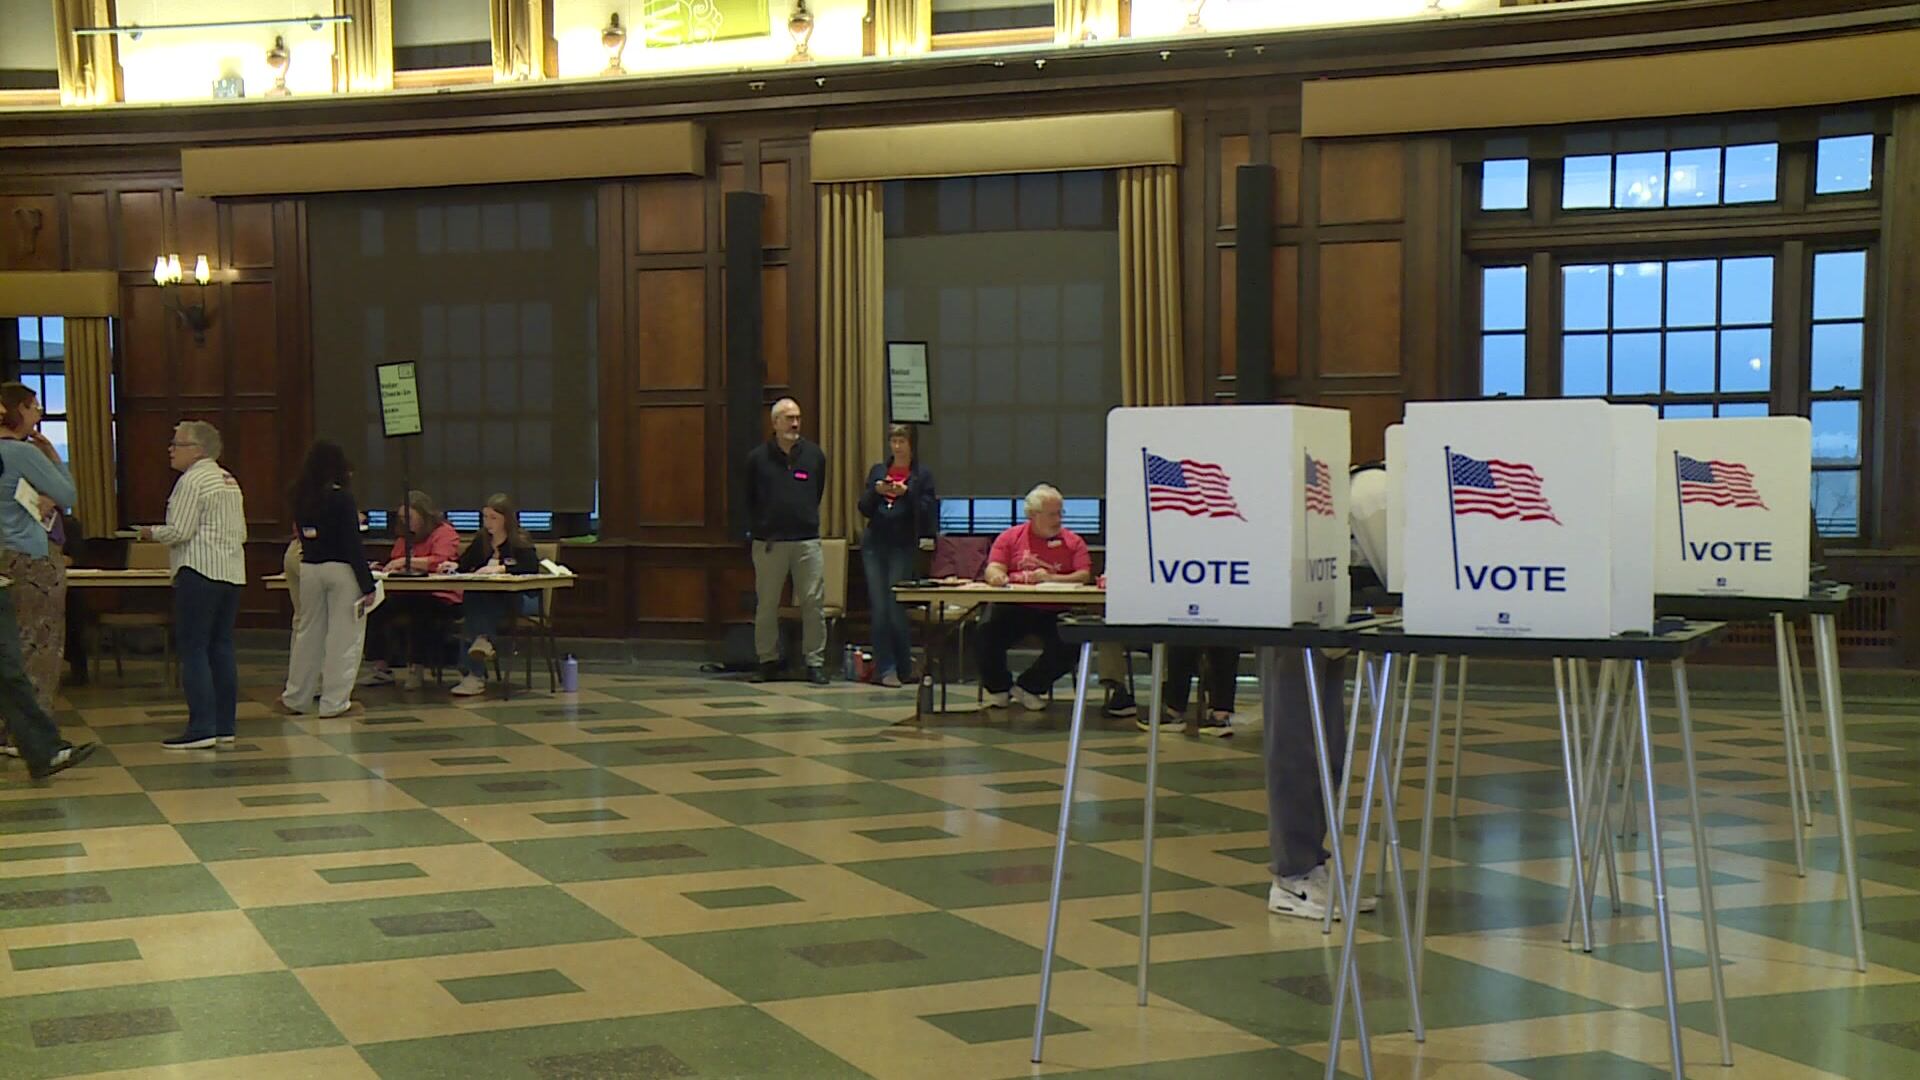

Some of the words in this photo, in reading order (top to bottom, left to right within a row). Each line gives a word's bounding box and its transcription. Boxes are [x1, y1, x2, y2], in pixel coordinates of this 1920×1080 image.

[1689, 541, 1772, 561] VOTE
[1158, 560, 1250, 585] VOTE
[1308, 557, 1338, 582] VOTE
[1464, 565, 1567, 592] VOTE
